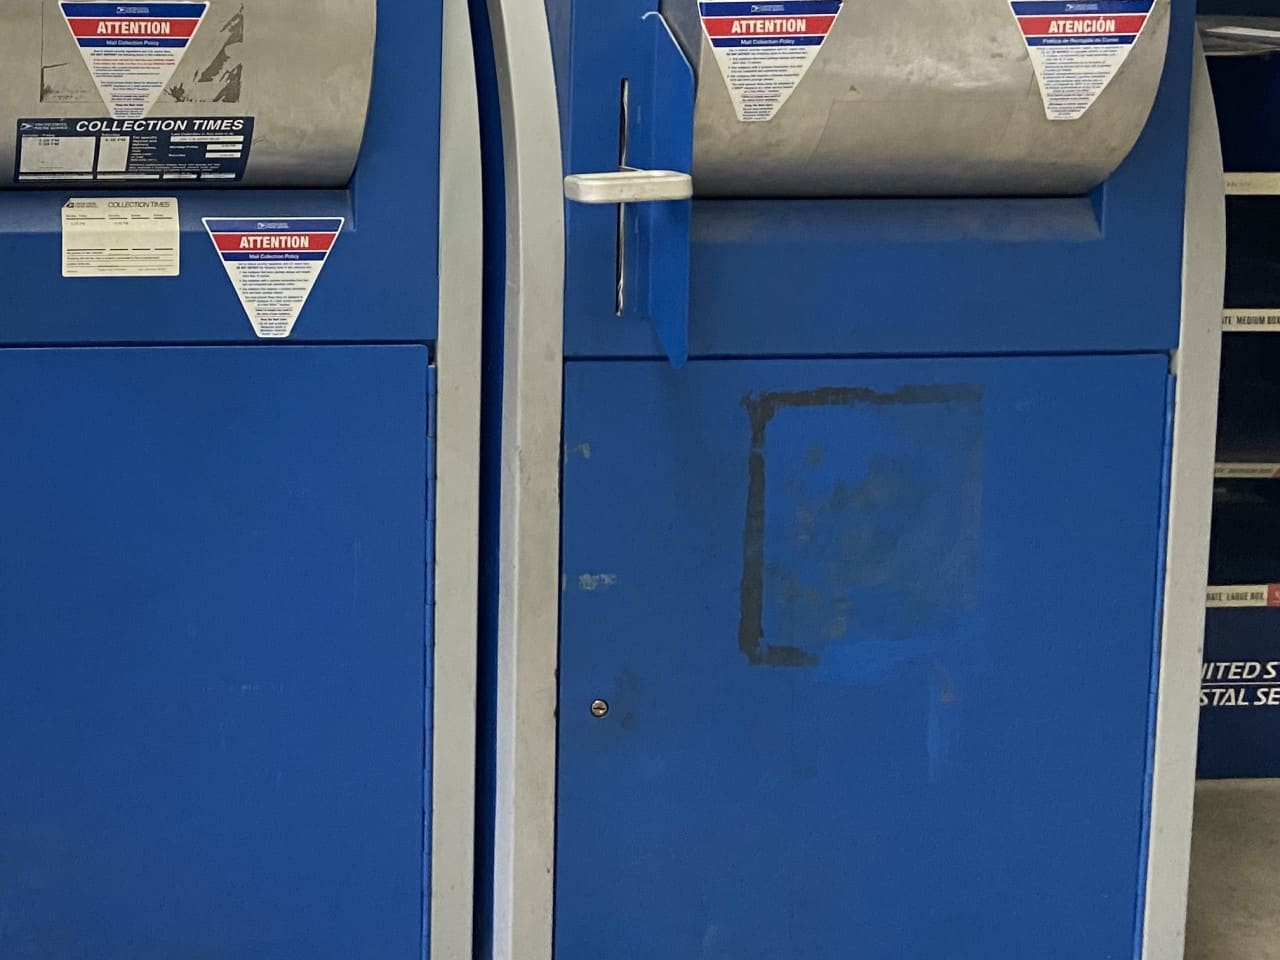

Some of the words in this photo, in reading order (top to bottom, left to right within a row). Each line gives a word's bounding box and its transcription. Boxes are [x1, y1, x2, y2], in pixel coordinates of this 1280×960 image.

[97, 21, 171, 34] ATTENTION
[731, 19, 806, 34] ATTENTION
[1048, 17, 1116, 33] ATENCIÓN
[75, 120, 189, 132] COLLECTION
[193, 119, 244, 131] TIMES
[107, 201, 150, 209] COLLECTION
[239, 236, 309, 248] ATTENTION
[1202, 662, 1261, 680] ITED
